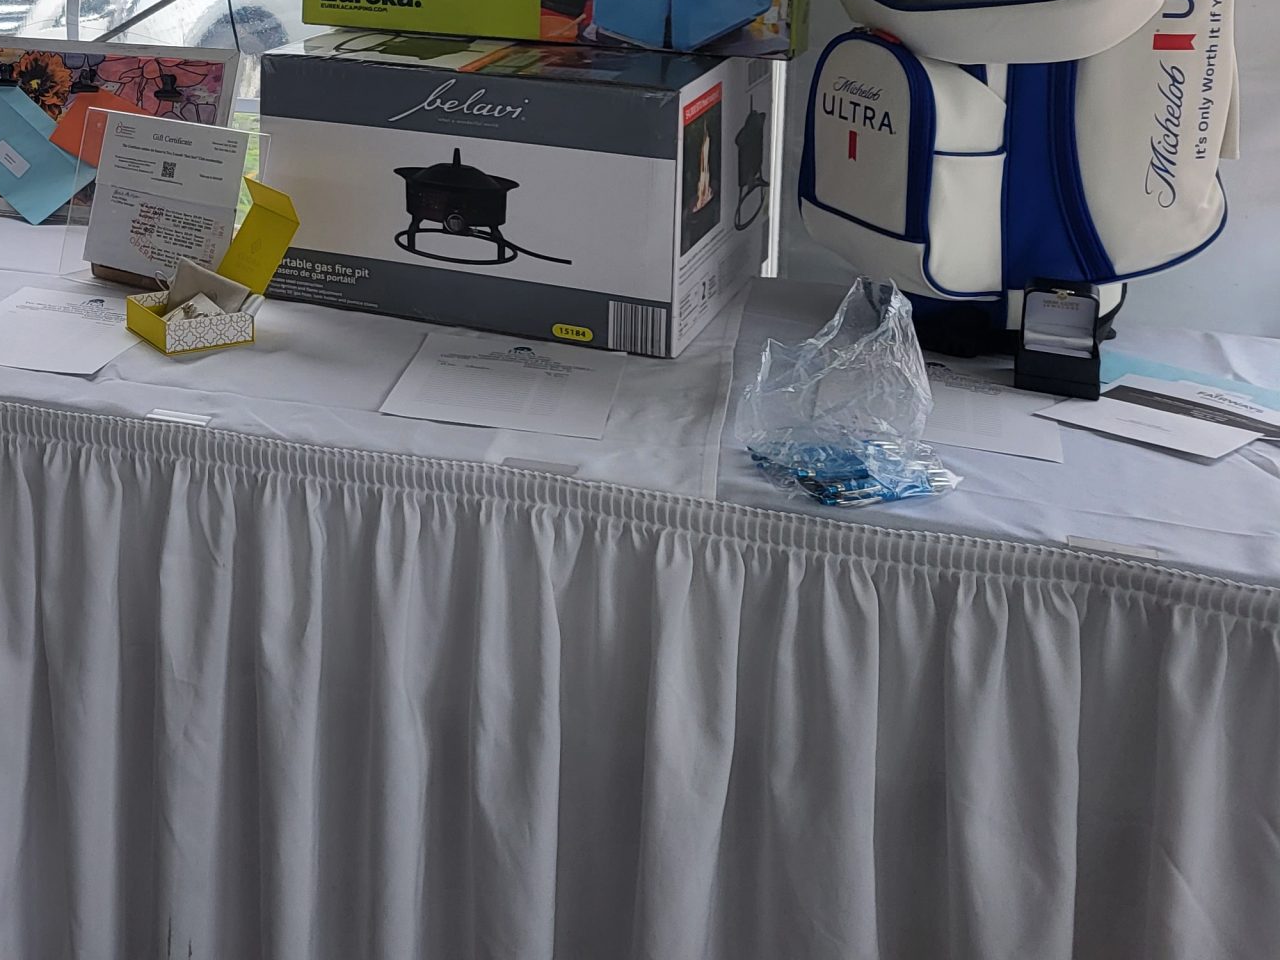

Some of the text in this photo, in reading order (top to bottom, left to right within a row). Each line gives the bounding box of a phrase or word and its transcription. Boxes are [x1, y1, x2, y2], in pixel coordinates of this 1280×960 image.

[320, 3, 388, 12] EUREKACAMPING.COM
[1210, 11, 1222, 22] If
[1208, 27, 1221, 38] It
[1201, 44, 1218, 92] Worth
[833, 76, 883, 101] Michelob
[388, 79, 529, 121] belavi
[823, 92, 894, 135] ULTRA
[1198, 97, 1214, 131] Only
[1145, 59, 1185, 208] Michelob
[1195, 137, 1207, 159] It's
[277, 268, 356, 284] asero de gas portátil
[282, 257, 370, 279] rtable gas fire pit
[559, 327, 587, 338] 15184
